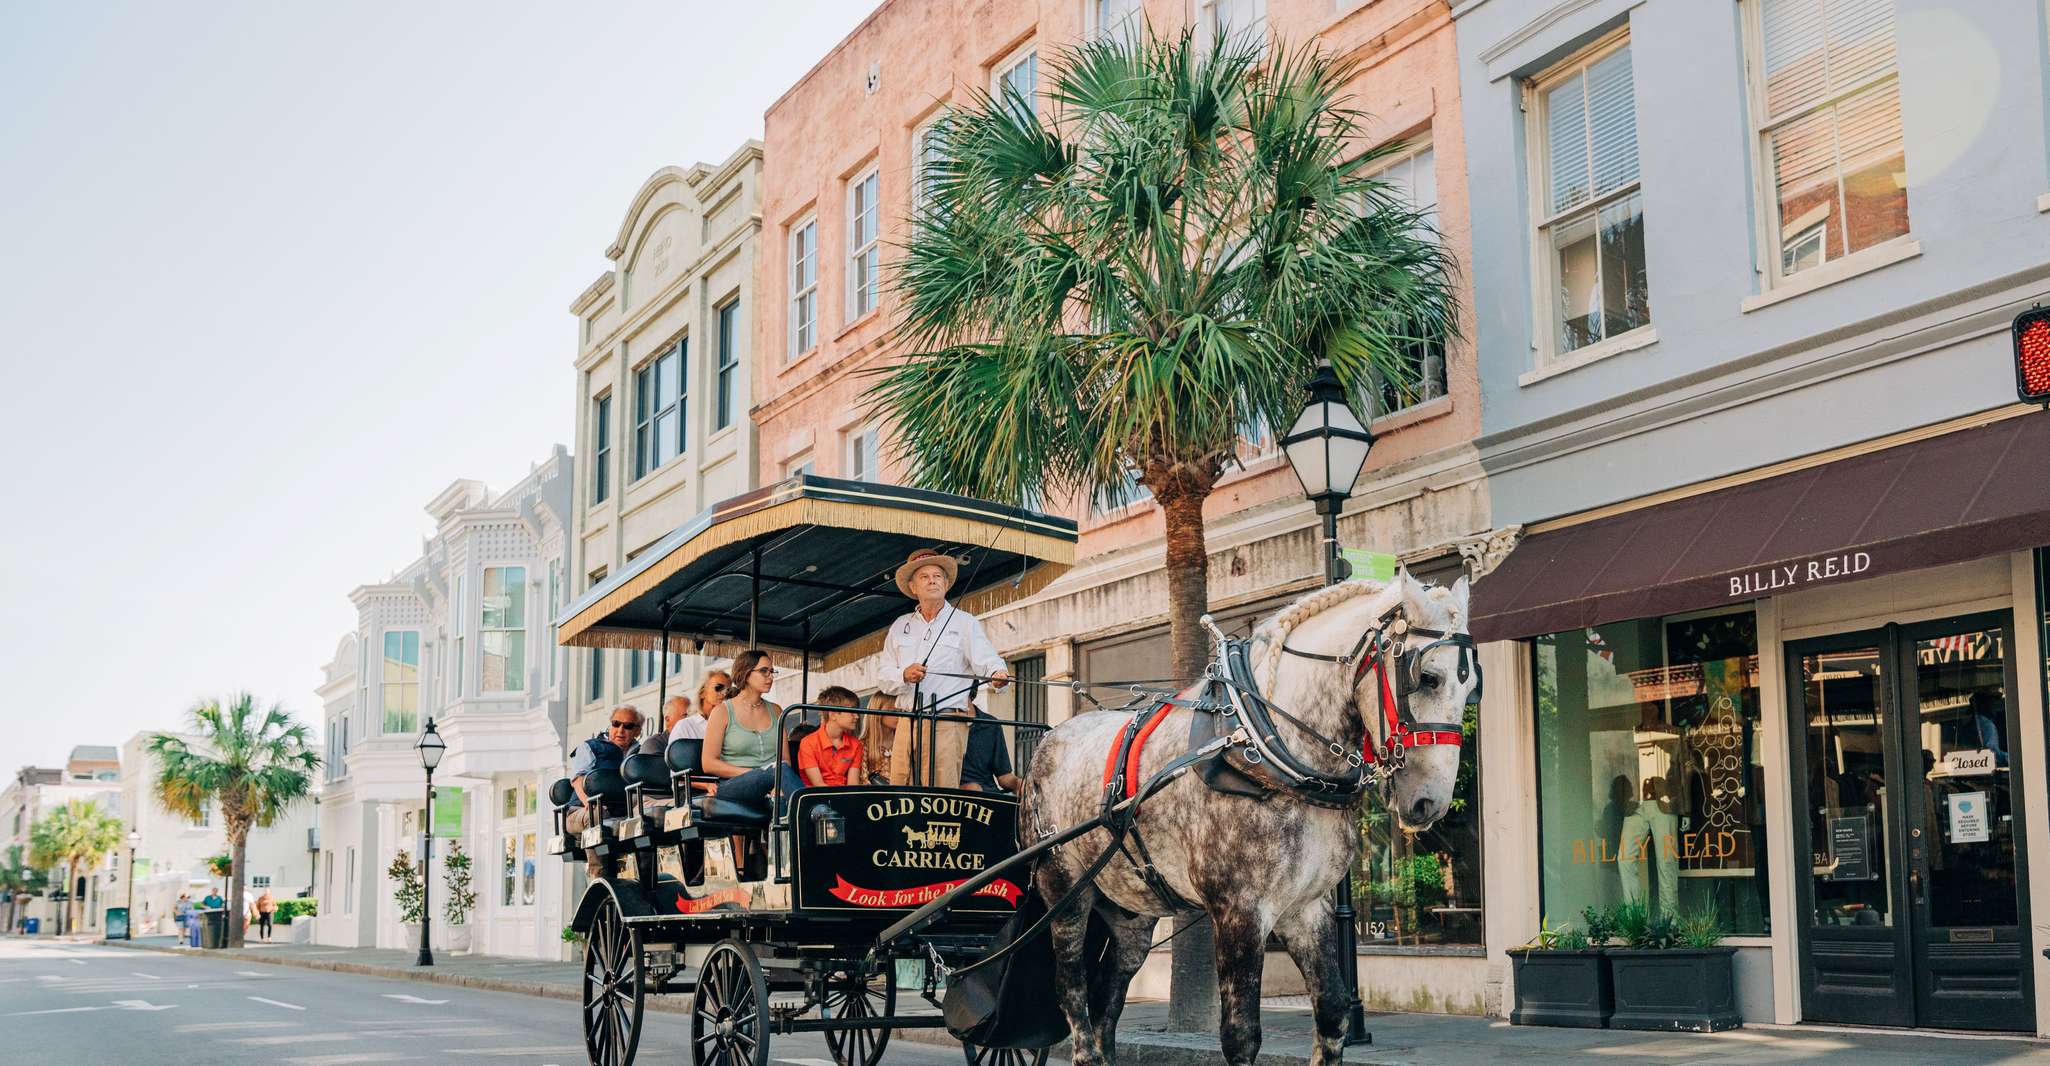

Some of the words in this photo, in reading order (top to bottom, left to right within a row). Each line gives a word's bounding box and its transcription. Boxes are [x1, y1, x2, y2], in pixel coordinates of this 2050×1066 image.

[1729, 565, 1798, 597] BILLY
[1806, 552, 1871, 582] REID
[1952, 756, 1988, 770] Closed
[866, 797, 915, 821] OLD
[920, 796, 994, 826] SOUTH
[1571, 835, 1651, 865] BILLY
[1663, 831, 1736, 860] REID
[872, 849, 985, 870] CARRIAGE
[847, 887, 887, 906] Look
[892, 890, 915, 906] for
[918, 886, 941, 902] the
[1366, 921, 1385, 935] 152
